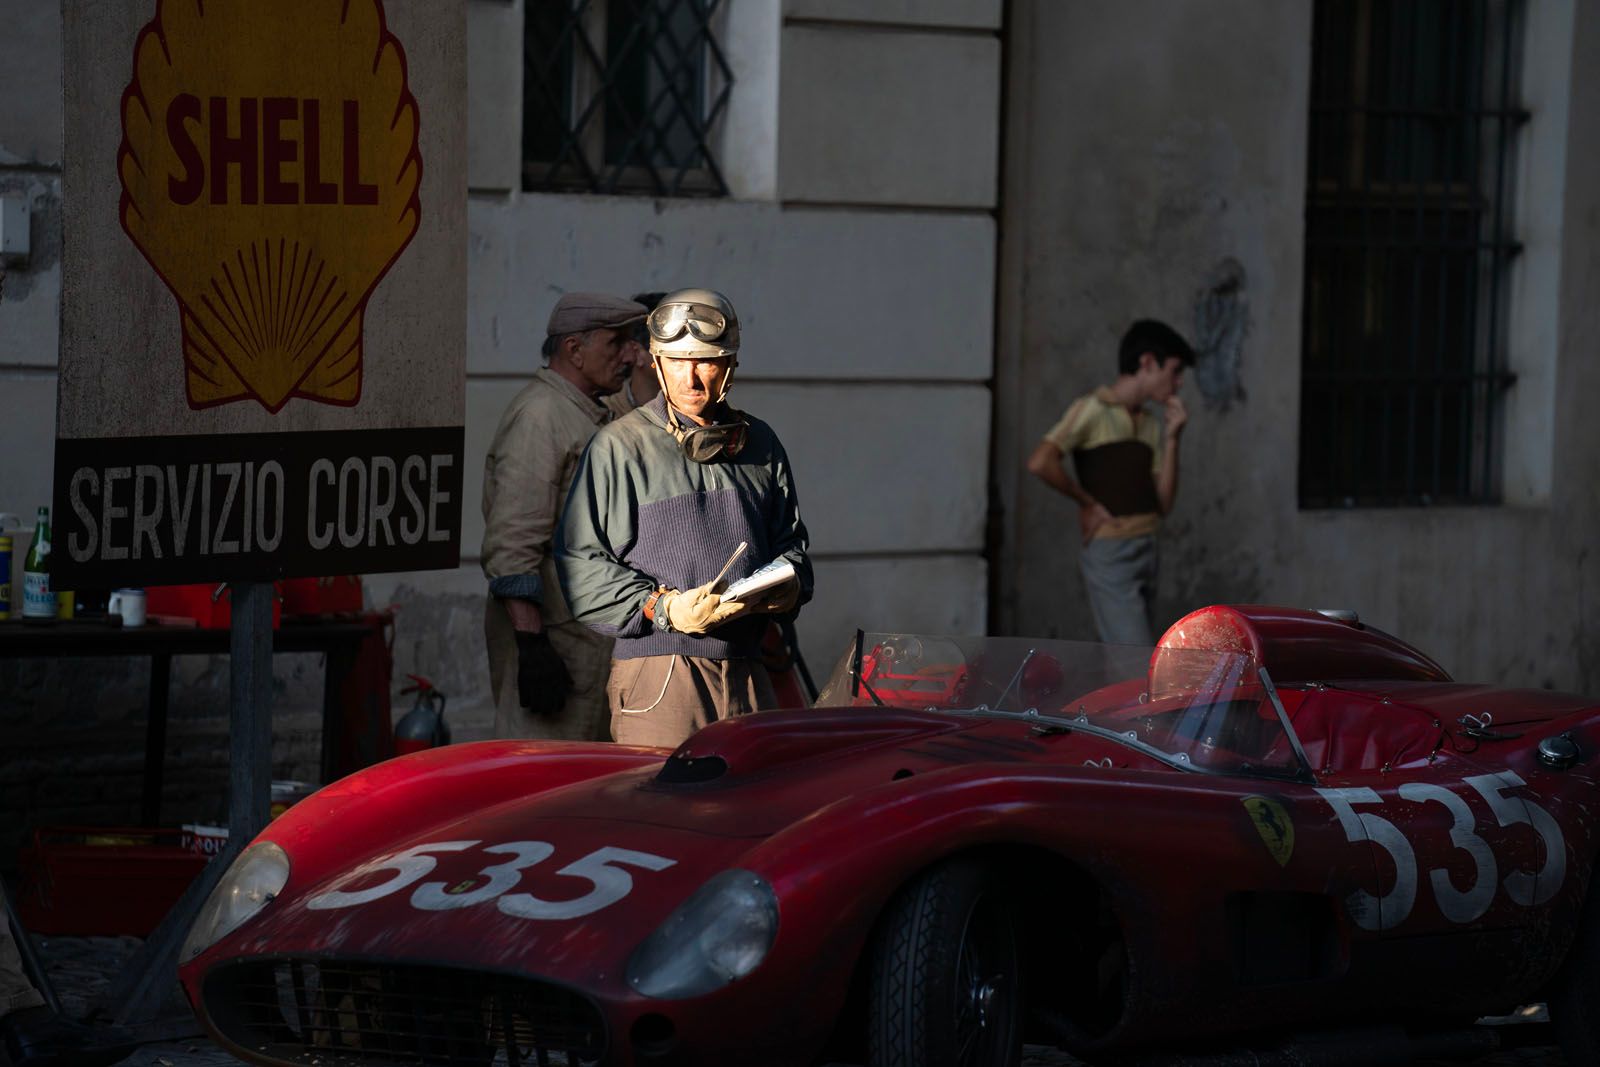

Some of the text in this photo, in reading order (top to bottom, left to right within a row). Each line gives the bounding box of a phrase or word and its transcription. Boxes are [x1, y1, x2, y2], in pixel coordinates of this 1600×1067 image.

[166, 93, 379, 205] SHELL
[67, 453, 454, 563] SERVIZIO CORSE
[306, 840, 679, 920] 535
[1312, 769, 1567, 931] 535
